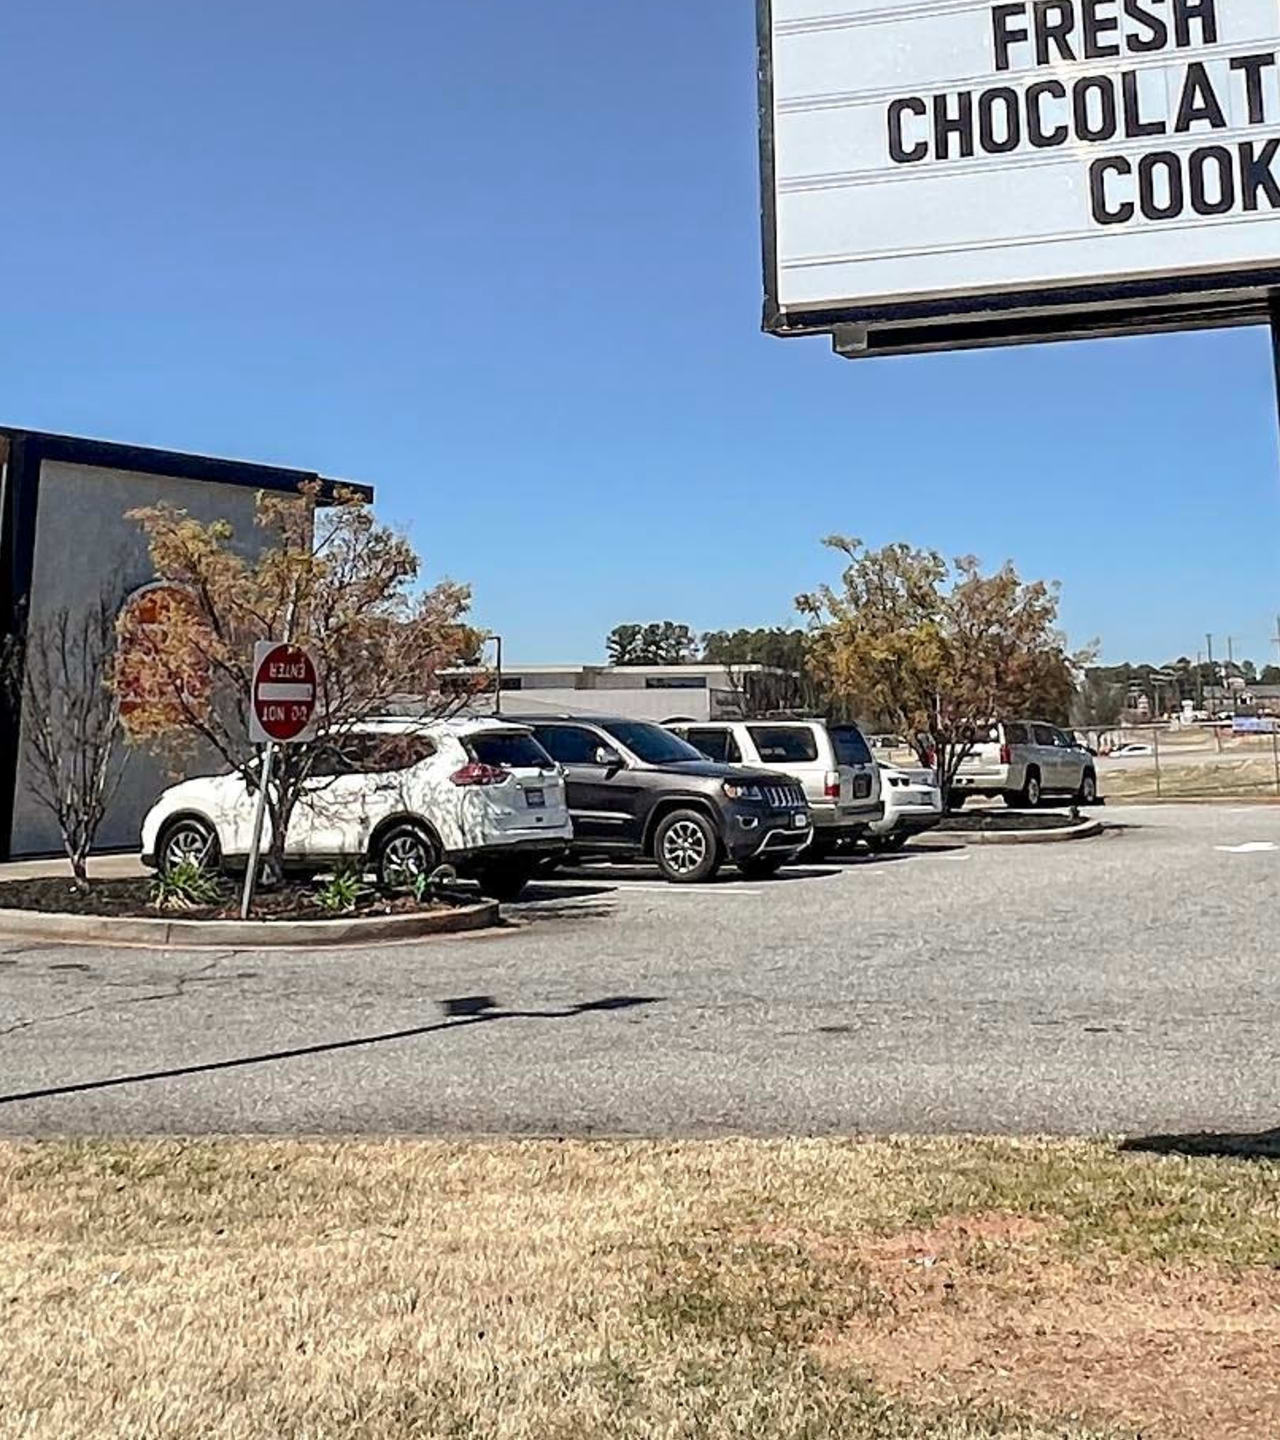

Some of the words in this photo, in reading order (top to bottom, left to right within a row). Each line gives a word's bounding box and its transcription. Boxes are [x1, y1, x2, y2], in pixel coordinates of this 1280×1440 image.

[269, 662, 306, 679] ENTER
[262, 705, 285, 721] NOT
[291, 705, 307, 721] DO
